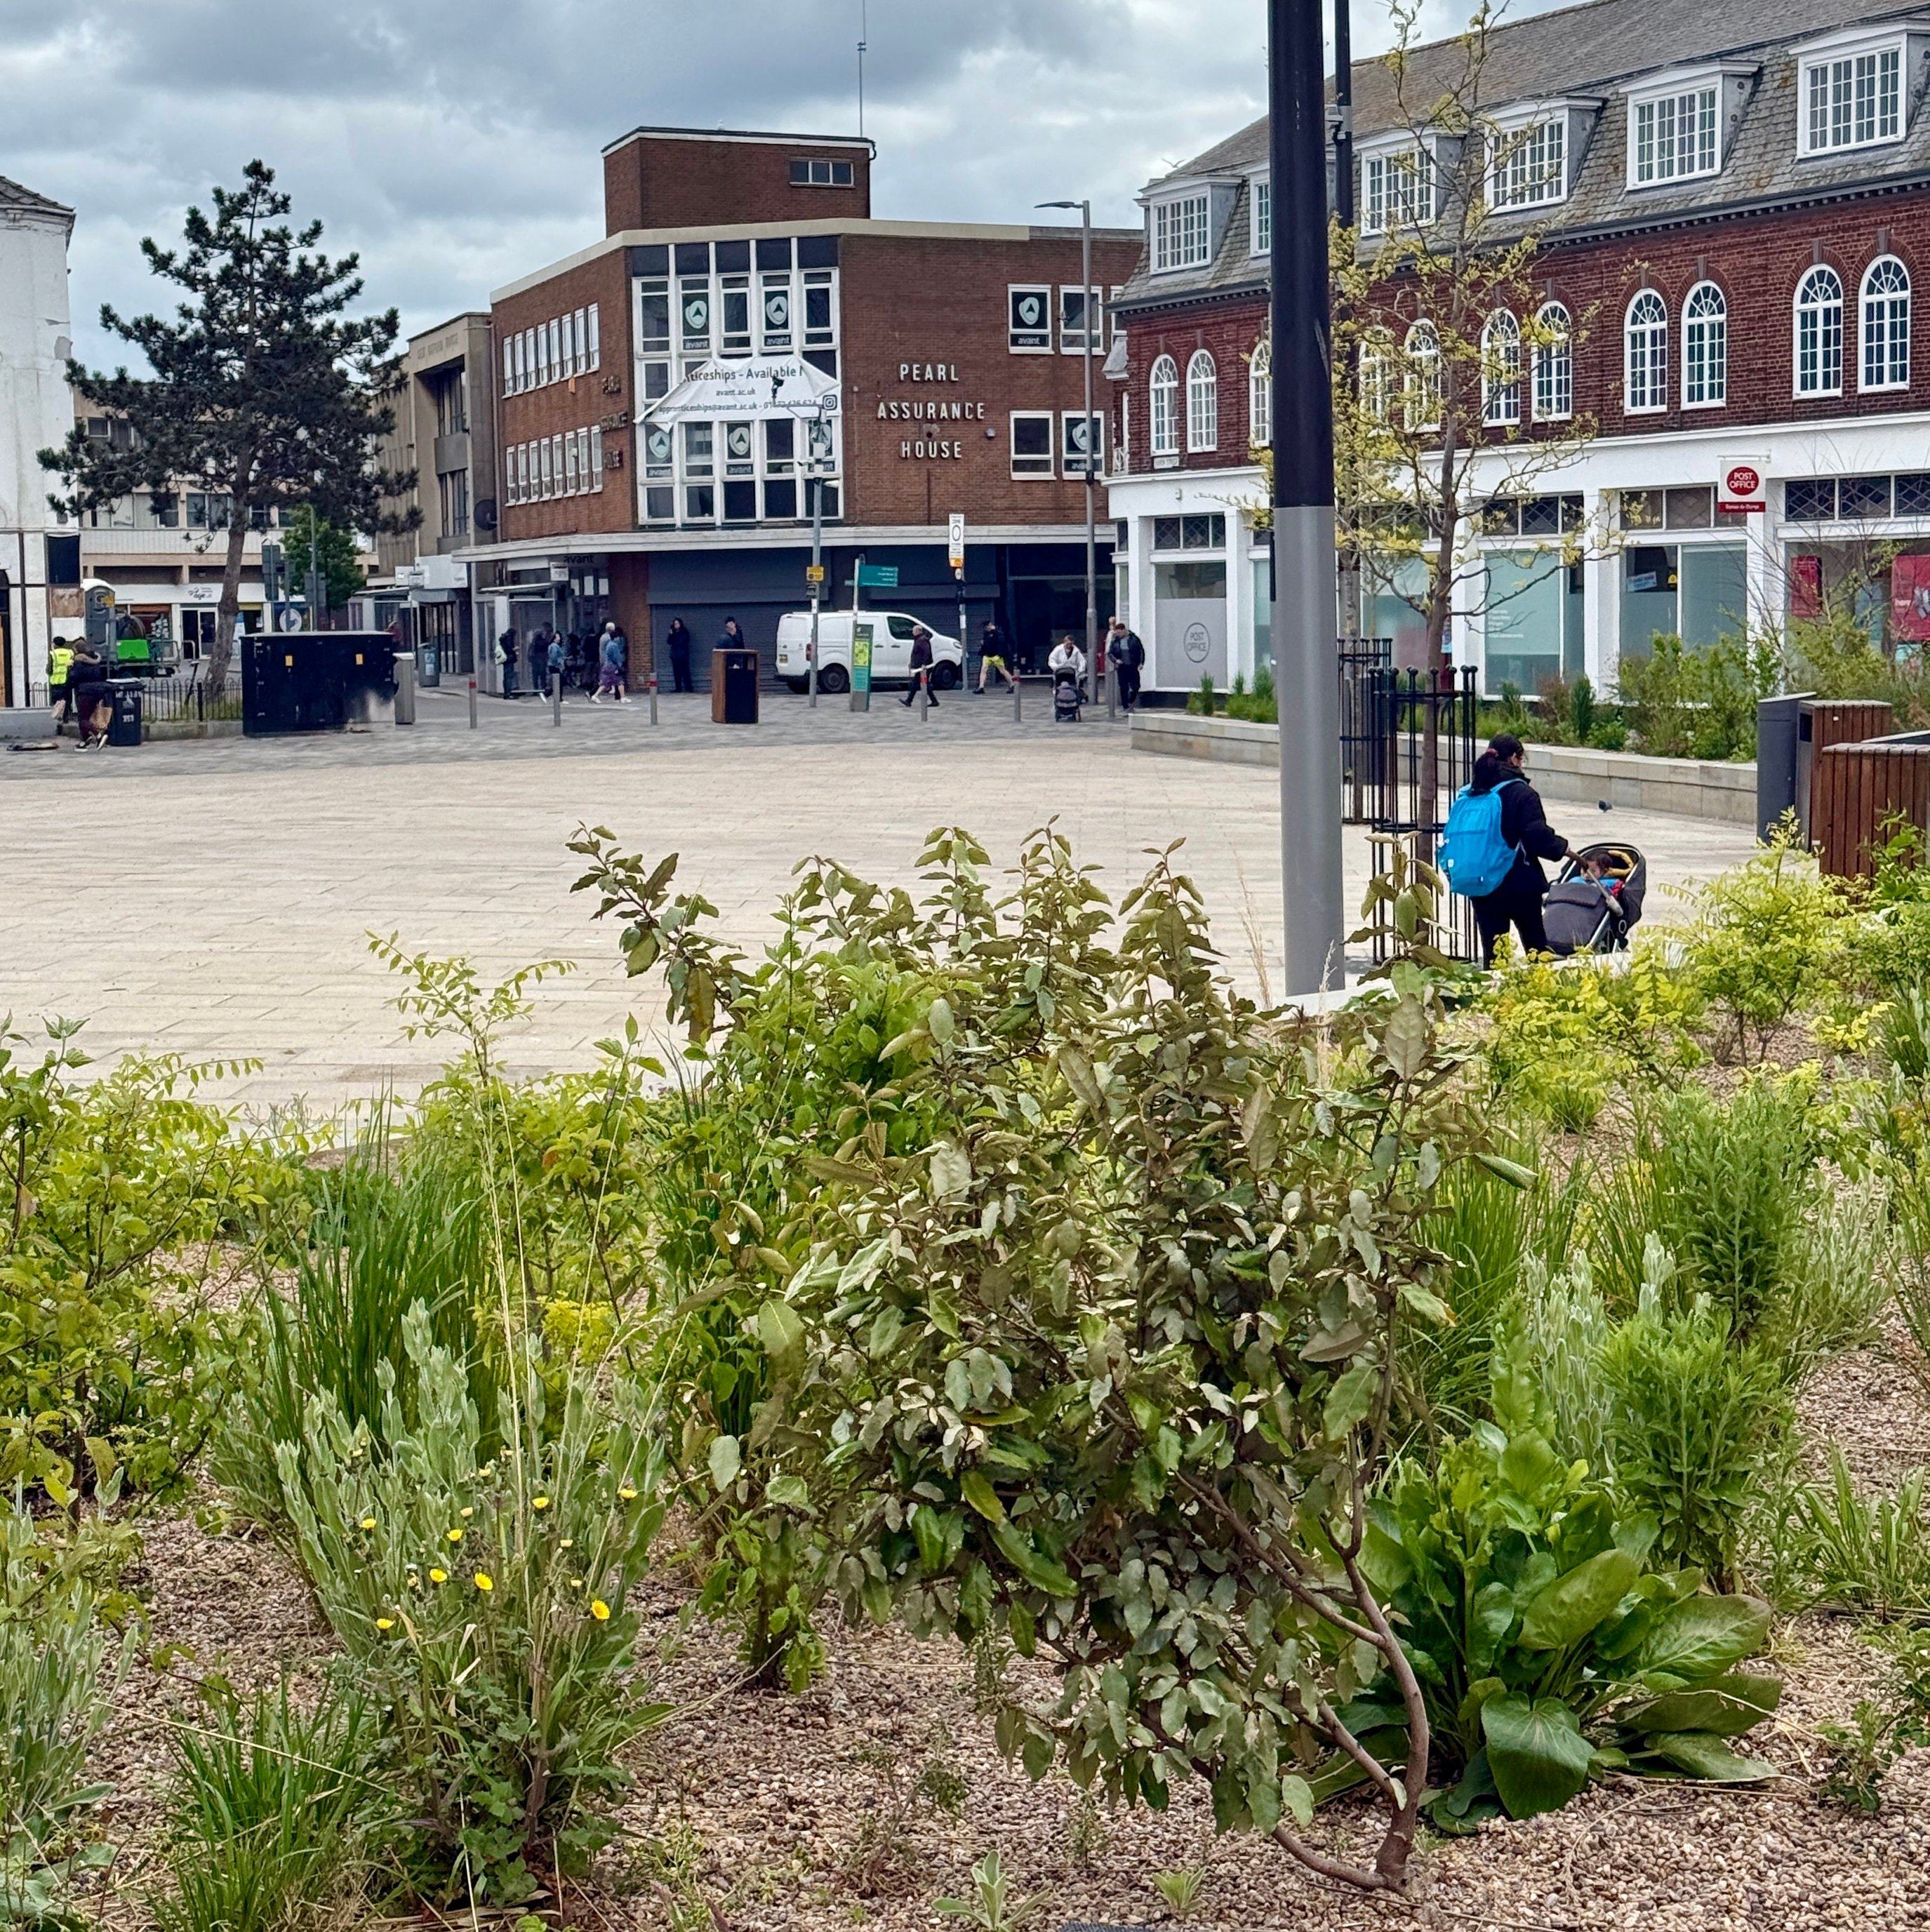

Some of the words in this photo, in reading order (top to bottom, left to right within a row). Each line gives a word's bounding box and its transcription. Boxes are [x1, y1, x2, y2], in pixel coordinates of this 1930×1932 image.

[766, 336, 790, 345] avant
[746, 366, 797, 379] Available
[900, 364, 959, 381] PEARL
[877, 401, 985, 420] ASSURANCE
[901, 441, 962, 458] HOUSE
[729, 465, 752, 474] avant
[1733, 472, 1754, 480] POST
[1729, 480, 1756, 489] OFFICE
[564, 555, 594, 564] avant
[1190, 632, 1204, 641] POST
[1186, 642, 1207, 652] OFFICE
